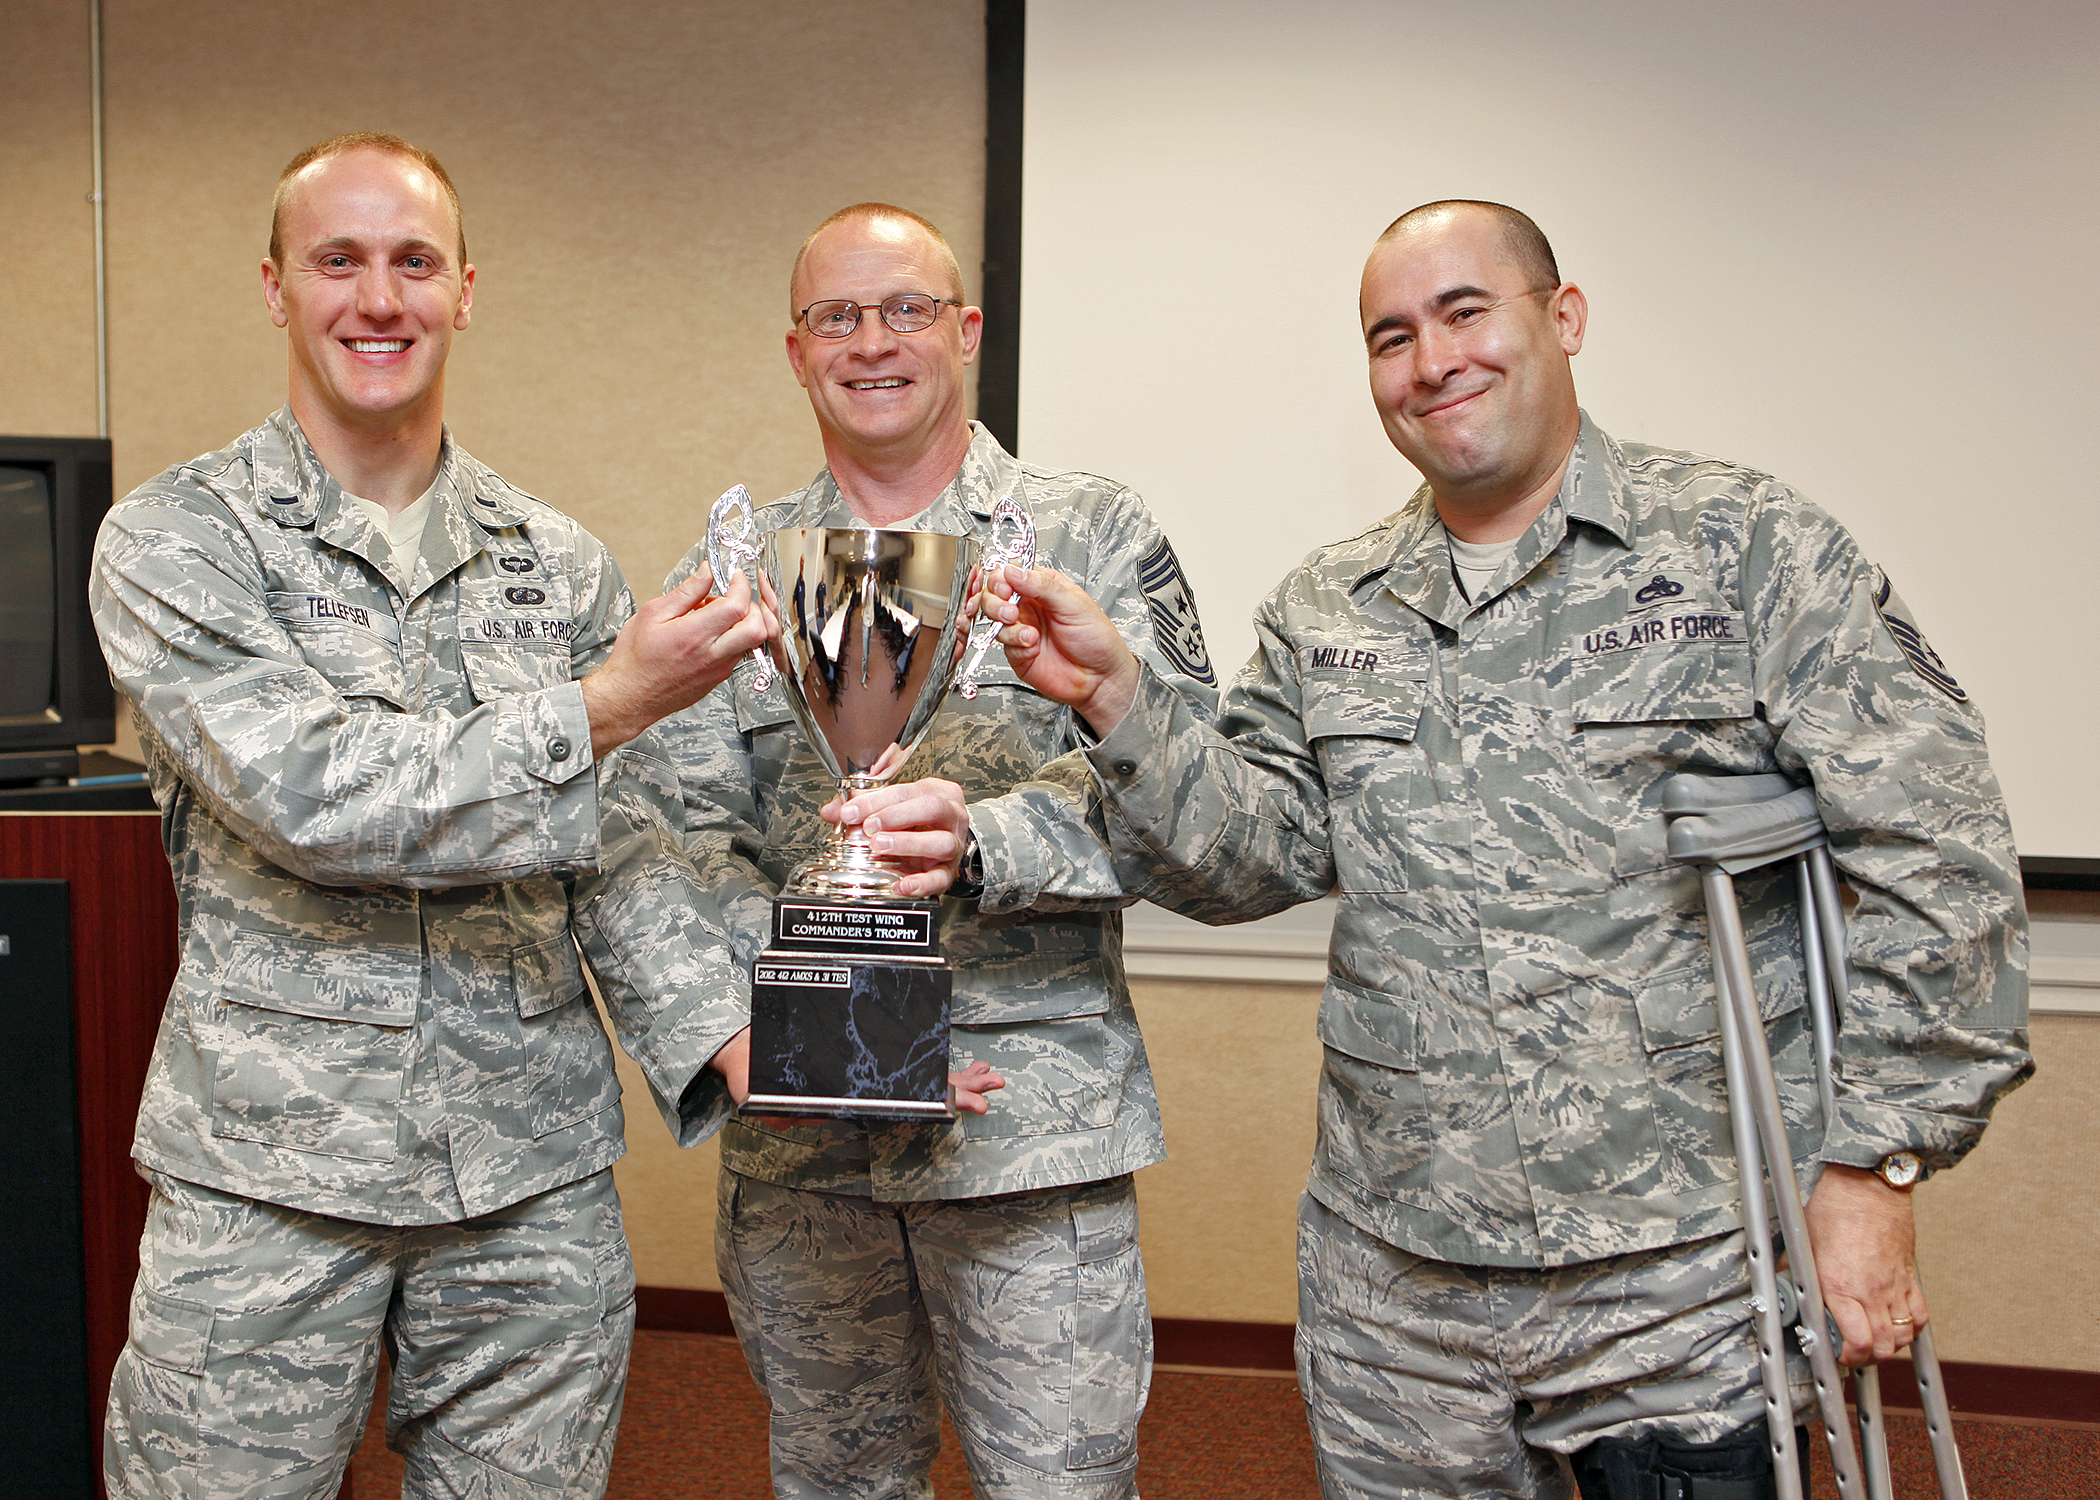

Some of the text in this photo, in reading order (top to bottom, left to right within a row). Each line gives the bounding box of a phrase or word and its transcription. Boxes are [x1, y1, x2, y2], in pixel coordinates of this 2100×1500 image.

[306, 597, 371, 628] TELLEFSEN
[483, 619, 572, 641] U.S. AIR FORC
[1585, 615, 1733, 653] U.S. AIR FORCE
[1311, 647, 1378, 671] MILLER
[807, 911, 904, 926] 412TH TEST WING
[792, 924, 919, 940] COMMANDER'S TROPHY
[777, 970, 790, 981] 412
[790, 971, 813, 982] AMXS
[831, 972, 848, 983] TES
